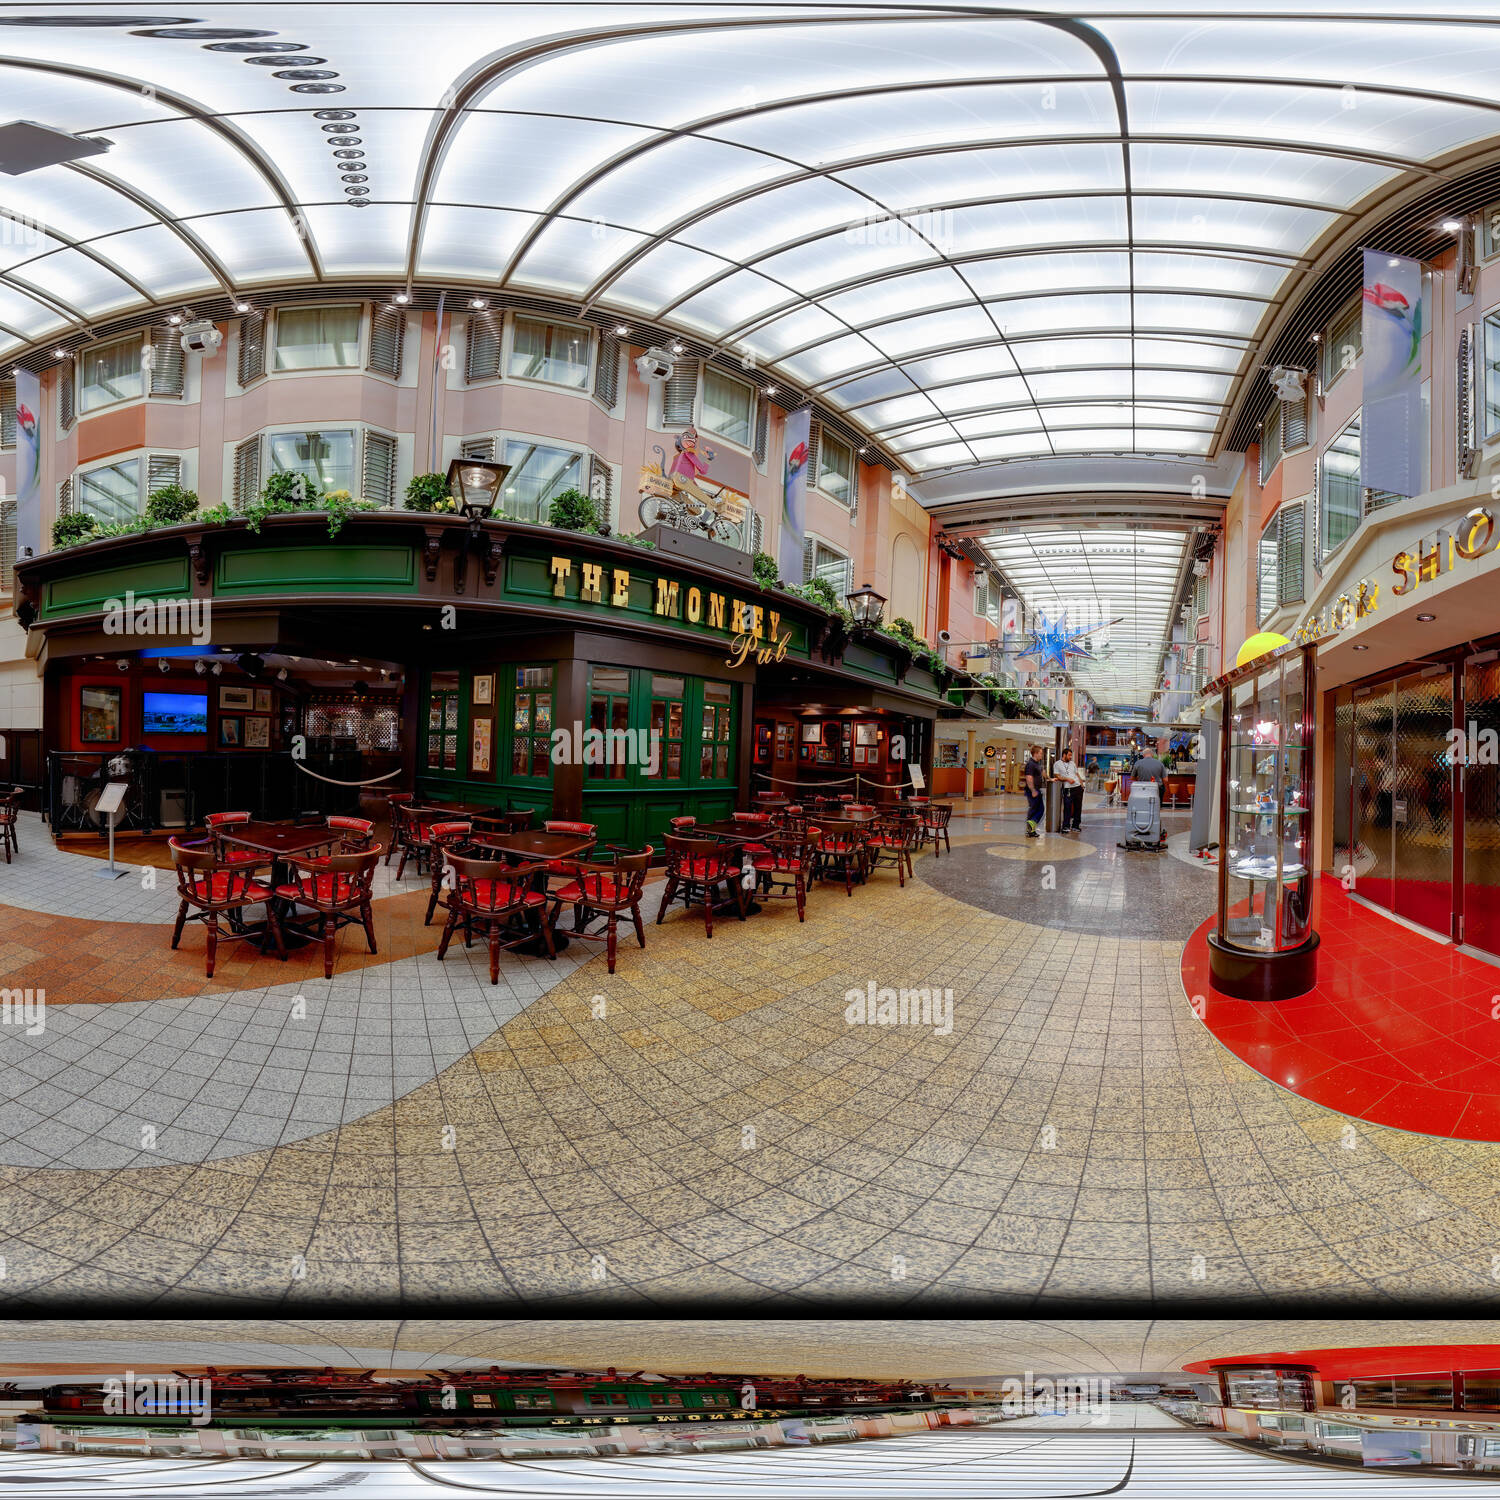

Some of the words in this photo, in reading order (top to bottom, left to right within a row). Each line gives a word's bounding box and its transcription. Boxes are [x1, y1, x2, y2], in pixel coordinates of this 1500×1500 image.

[552, 556, 630, 608] THE
[655, 577, 781, 643] MONKEY
[726, 631, 792, 669] Pub
